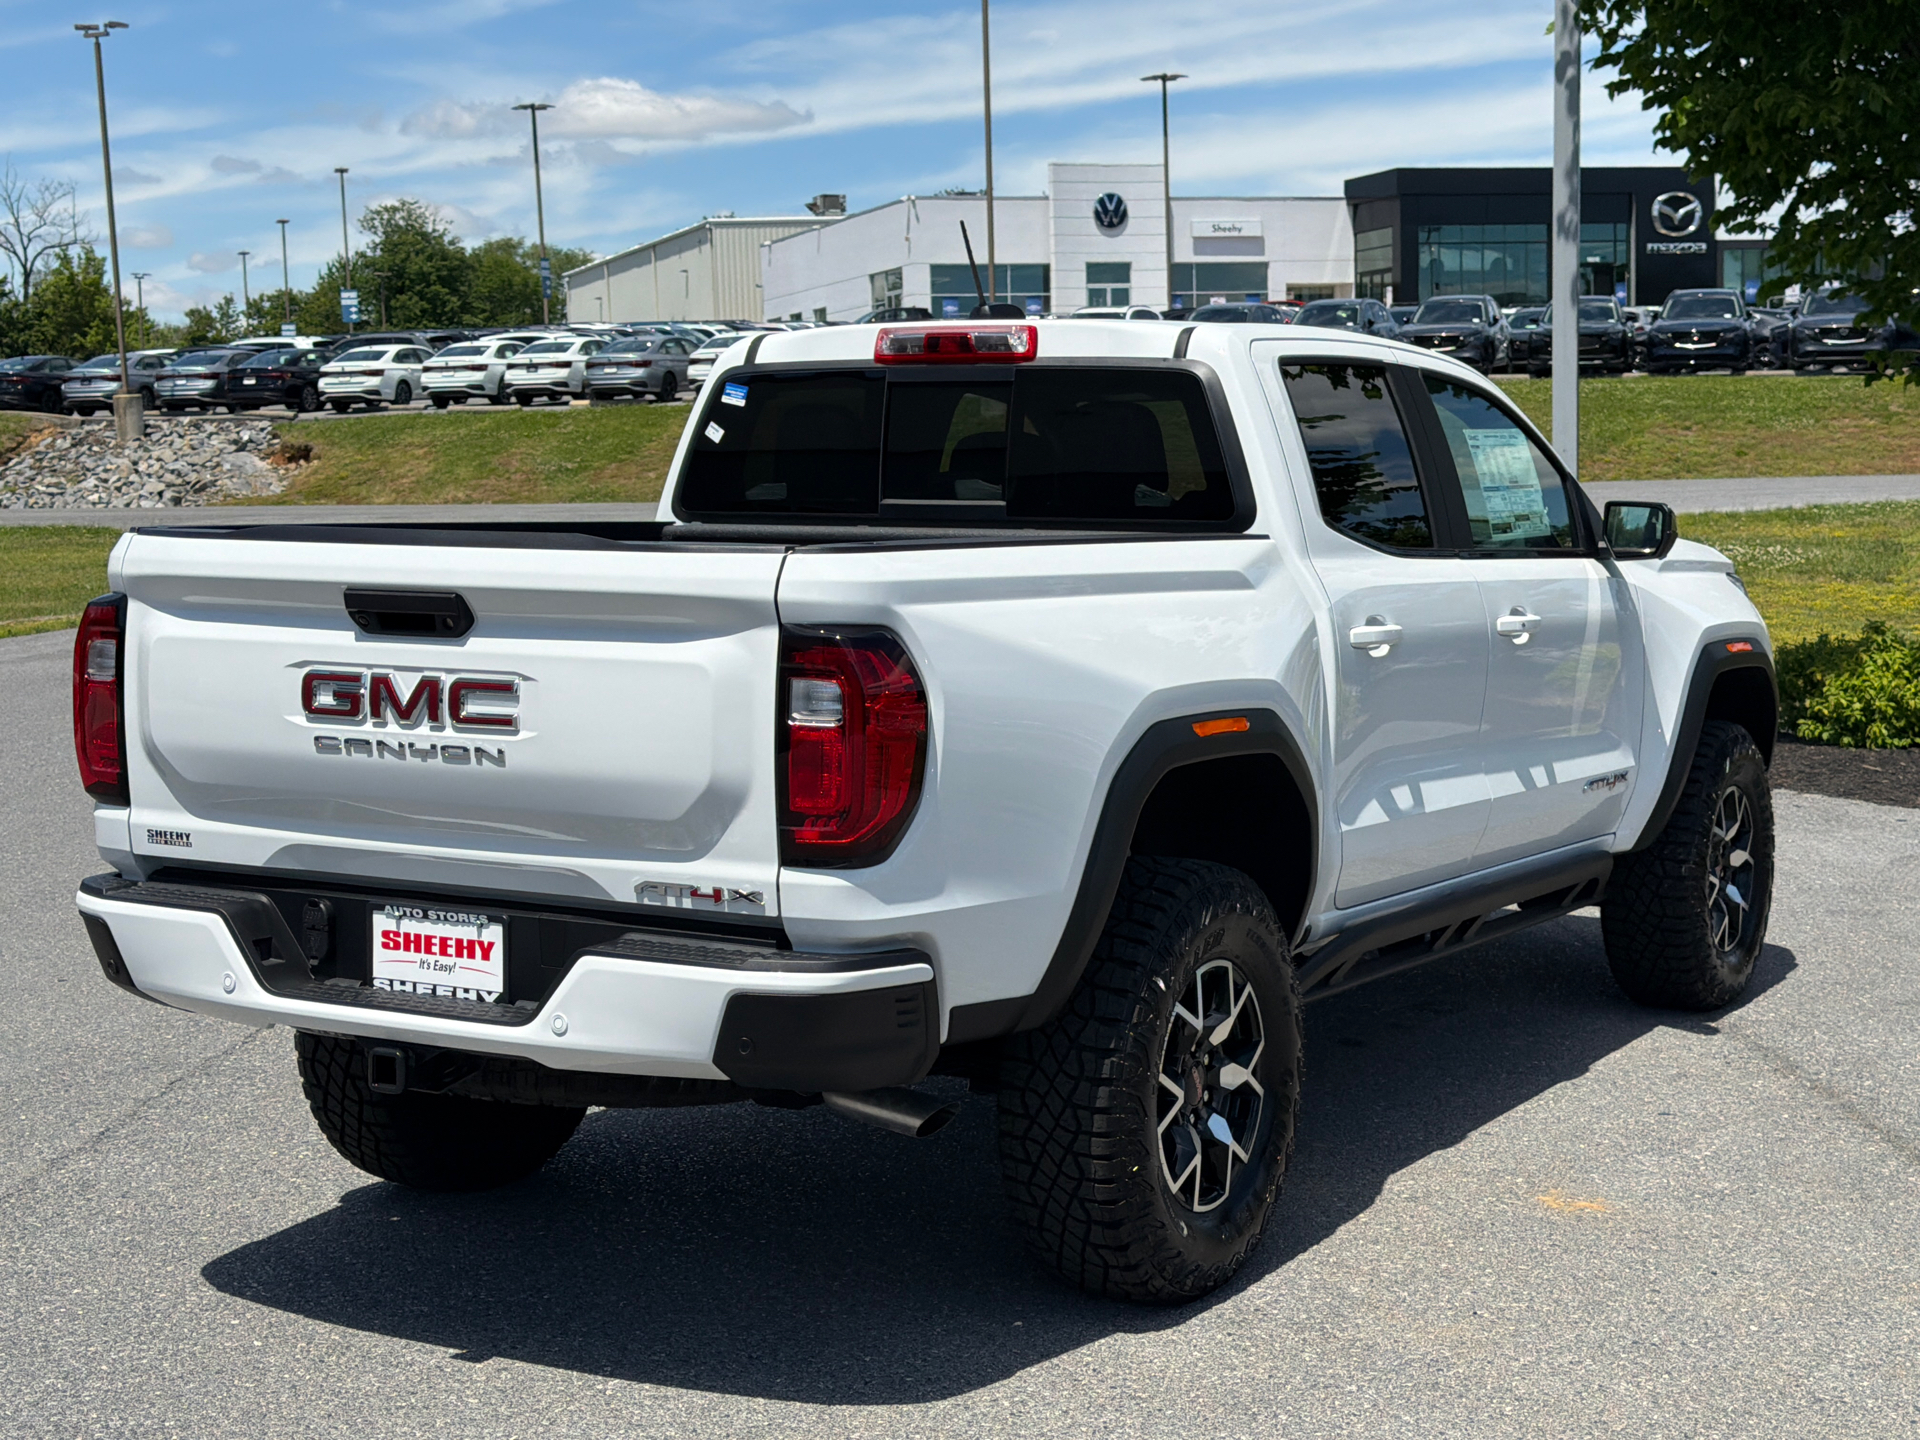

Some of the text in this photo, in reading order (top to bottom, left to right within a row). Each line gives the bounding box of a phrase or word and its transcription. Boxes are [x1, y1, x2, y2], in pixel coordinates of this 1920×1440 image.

[1211, 223, 1243, 234] Sheehy
[302, 669, 519, 731] GMC
[314, 735, 506, 767] CANYON
[146, 828, 191, 841] SHEEHY
[634, 880, 765, 906] AT4X
[384, 905, 489, 924] AUTO STORES
[381, 929, 496, 962] SHEEHY
[419, 958, 457, 975] It's Easy!
[372, 978, 500, 1002] SHEEHY
